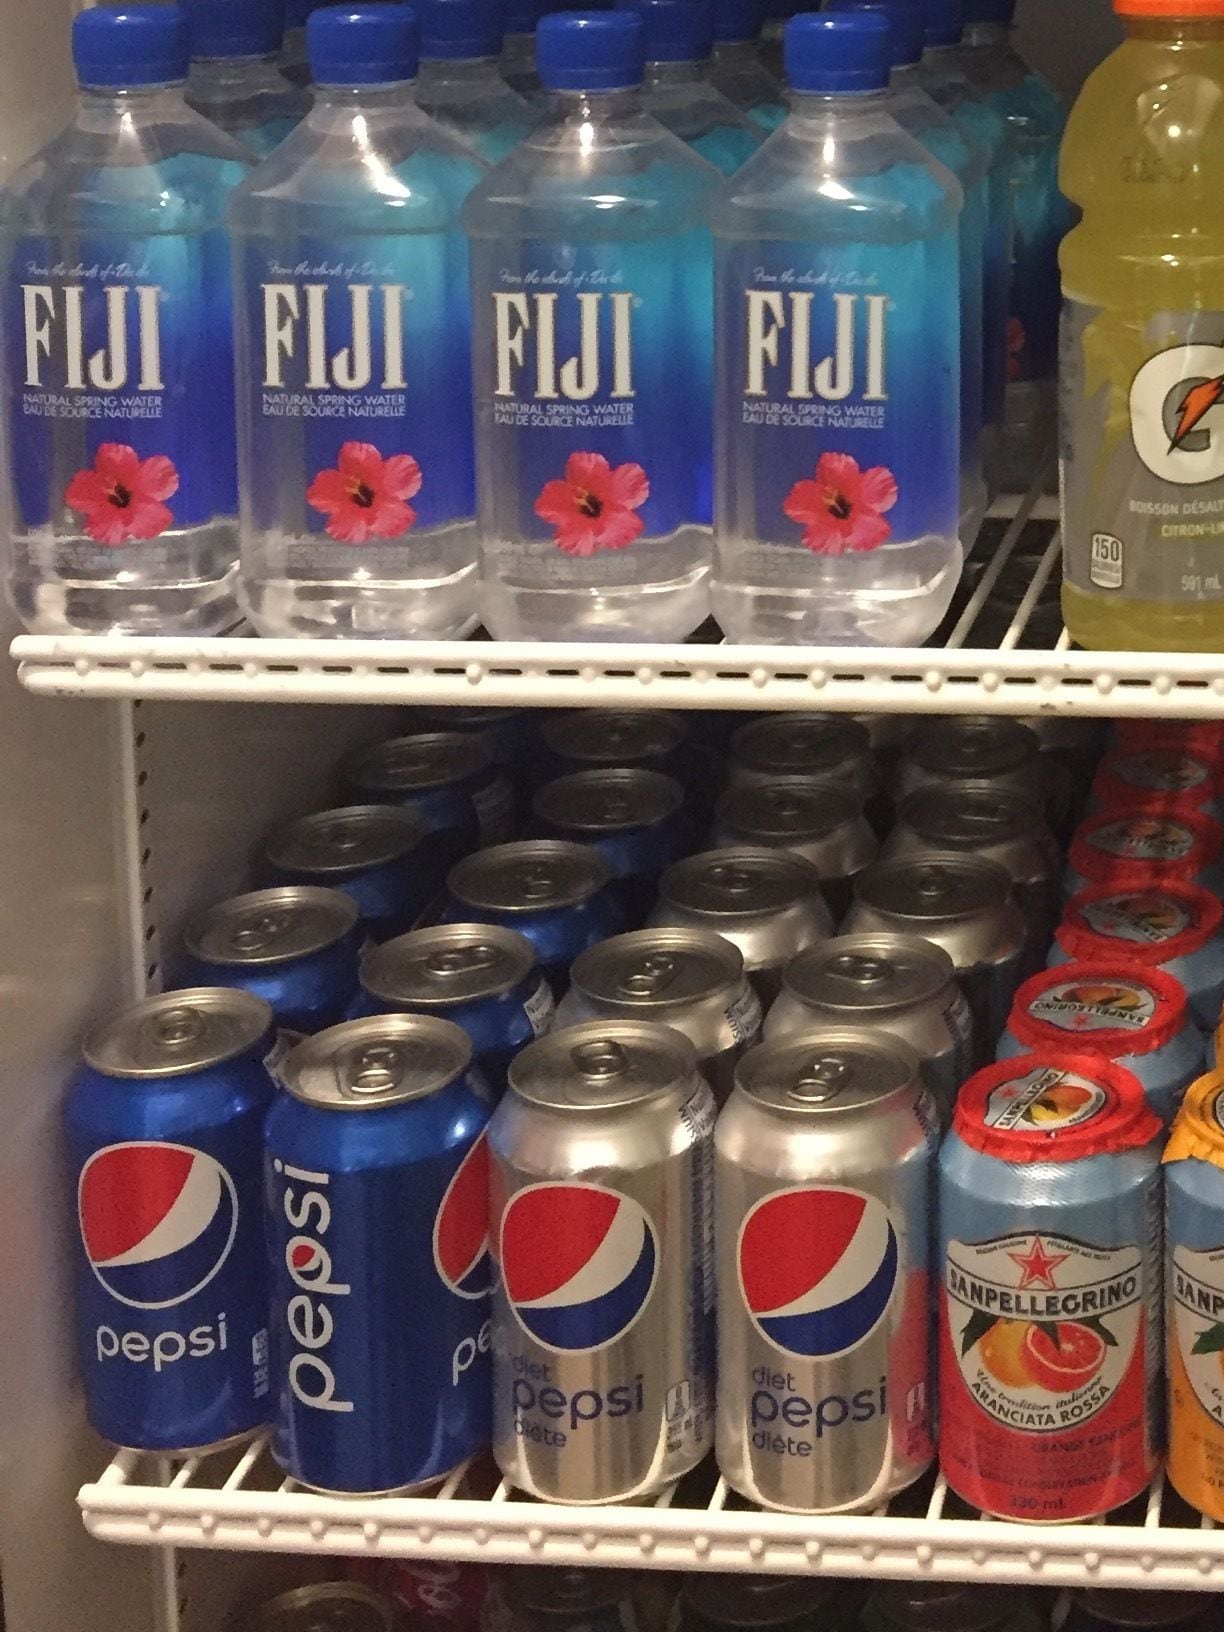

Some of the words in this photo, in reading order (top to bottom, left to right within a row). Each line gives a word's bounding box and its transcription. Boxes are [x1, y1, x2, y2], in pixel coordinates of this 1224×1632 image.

[20, 284, 165, 391] FIJI
[260, 283, 407, 390] FIJI
[492, 292, 636, 400] FIJI
[744, 289, 888, 400] FIJI
[23, 394, 71, 406] NATURAL
[75, 395, 118, 407] SPRING
[121, 396, 162, 406] WATER
[60, 407, 101, 418] SOURCE
[104, 407, 162, 418] NATURELLE
[262, 394, 315, 406] NATURAL
[318, 394, 362, 406] SPRING
[364, 394, 405, 406] WATER
[263, 405, 284, 416] EAU
[286, 405, 300, 416] DE
[302, 406, 345, 417] SOURCE
[348, 405, 406, 417] NATURELLE
[494, 403, 542, 415] NATURAL
[546, 404, 590, 416] SPRING
[593, 403, 634, 414] WATER
[742, 401, 794, 414] NATURAL
[799, 403, 842, 416] SPRING
[845, 405, 885, 417] WATER
[516, 414, 529, 425] DE
[531, 415, 573, 427] SOURCE
[576, 415, 634, 427] NATURELLE
[766, 413, 779, 424] DE
[782, 415, 825, 428] SOURCE
[828, 416, 885, 429] NATURELLE
[1129, 500, 1178, 515] BOISSON
[1094, 537, 1119, 561] 150
[274, 1158, 354, 1412] pepsi
[950, 1267, 1137, 1316] SANPELLEGRINO
[96, 1312, 227, 1372] pepsi
[751, 1366, 796, 1391] diet
[512, 1374, 644, 1429] pepsi
[751, 1376, 888, 1438] pepsi
[971, 1382, 1055, 1426] ARANCIATA
[1060, 1385, 1110, 1422] ROSSA
[752, 1430, 812, 1457] diète
